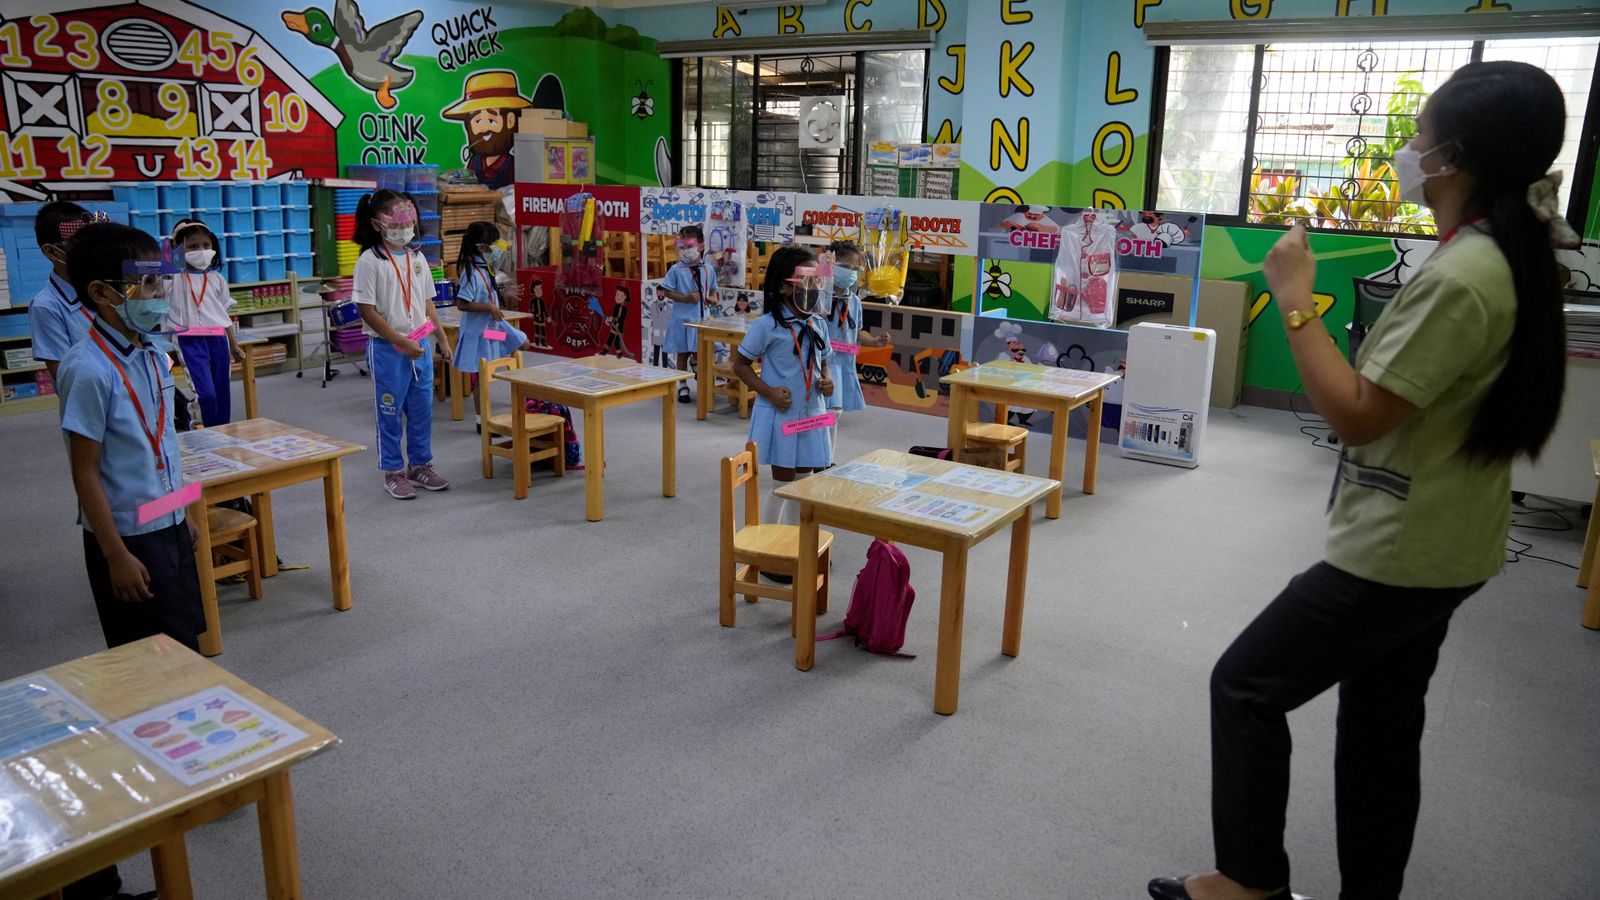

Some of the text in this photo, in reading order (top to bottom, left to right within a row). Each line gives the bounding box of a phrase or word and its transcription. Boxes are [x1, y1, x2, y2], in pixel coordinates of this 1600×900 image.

[432, 6, 497, 47] QUACK
[1, 15, 264, 87] 1 2 3 4 5 6
[438, 31, 503, 70] QUACK
[938, 40, 1138, 105] J K L
[96, 80, 307, 132] 8 9 10
[359, 113, 428, 143] OINK
[990, 117, 1030, 171] N
[1092, 121, 1135, 176] O
[58, 133, 114, 178] 12
[175, 138, 221, 180] 13
[229, 138, 272, 180] 14
[361, 146, 426, 165] OINK
[522, 197, 629, 218] FIREMA OOTH
[911, 216, 961, 233] BOOTH
[1009, 231, 1163, 257] CHEF OTH
[1126, 297, 1166, 307] SHARP
